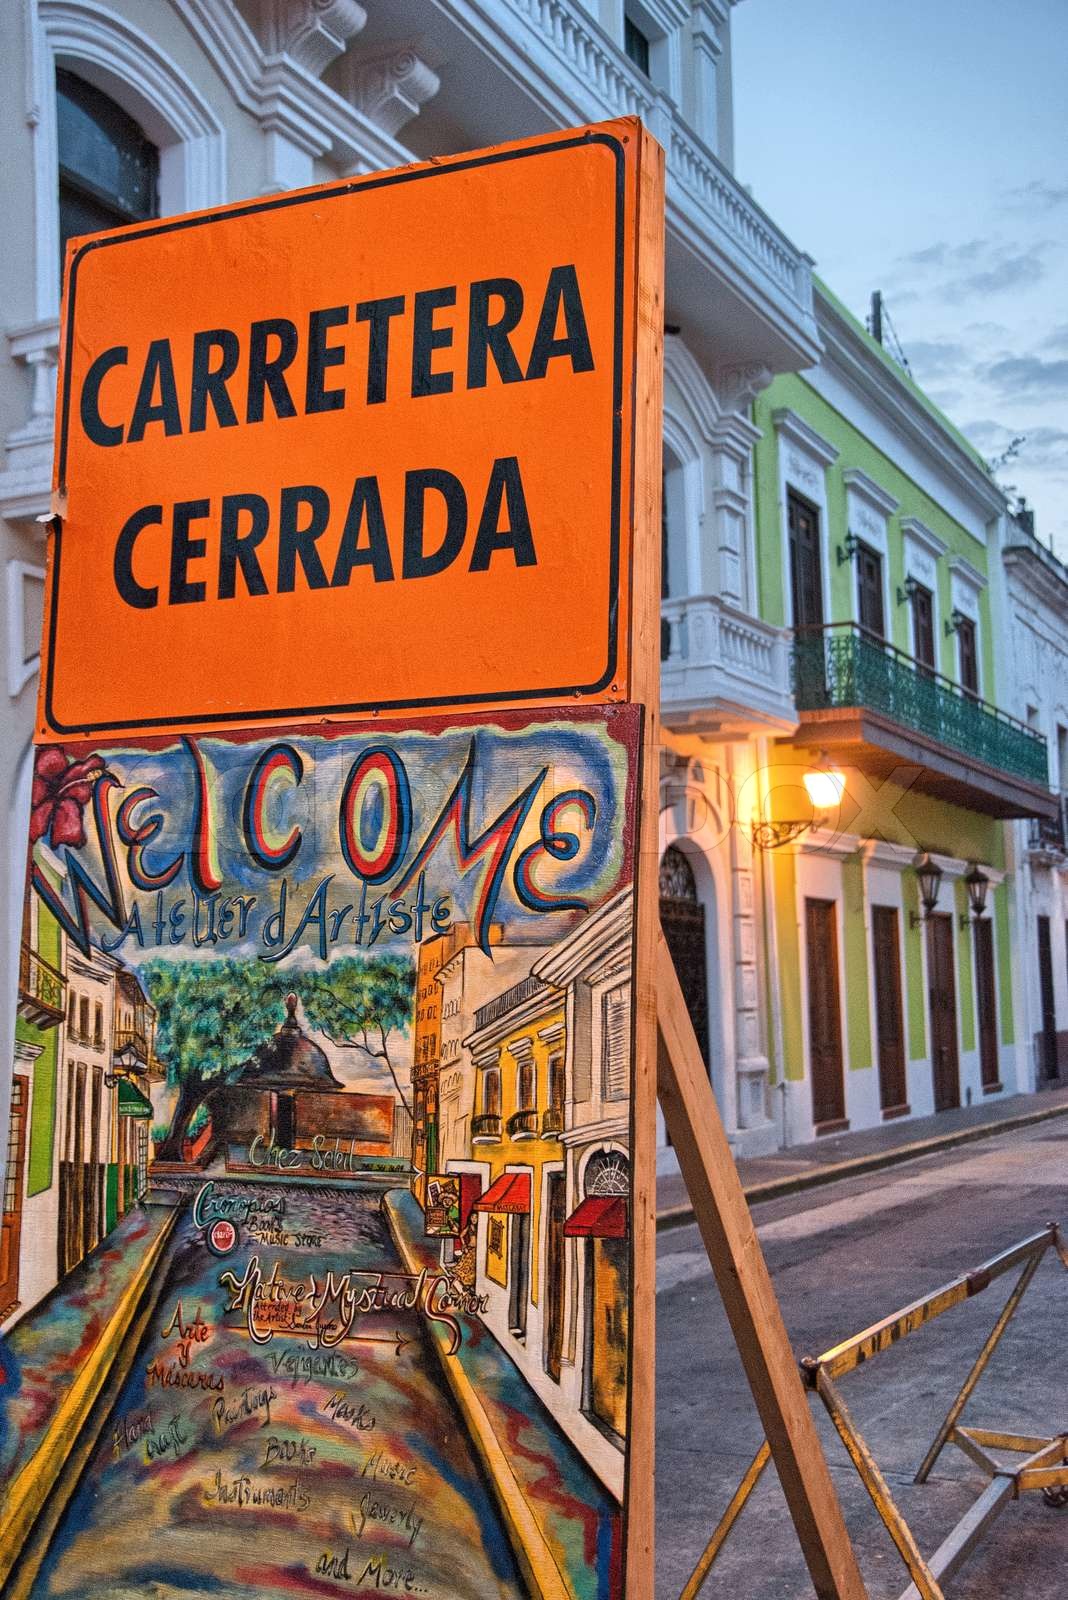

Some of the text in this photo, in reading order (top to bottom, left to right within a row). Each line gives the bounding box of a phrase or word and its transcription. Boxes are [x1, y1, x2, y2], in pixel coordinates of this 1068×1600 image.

[79, 264, 596, 447] CARRETERA
[113, 456, 538, 609] CERRADA
[100, 889, 258, 952] Atelier
[249, 1128, 356, 1171] Chez Soleil
[161, 1296, 209, 1342] Arte
[219, 1255, 305, 1345] Native
[315, 1549, 352, 1581] and
